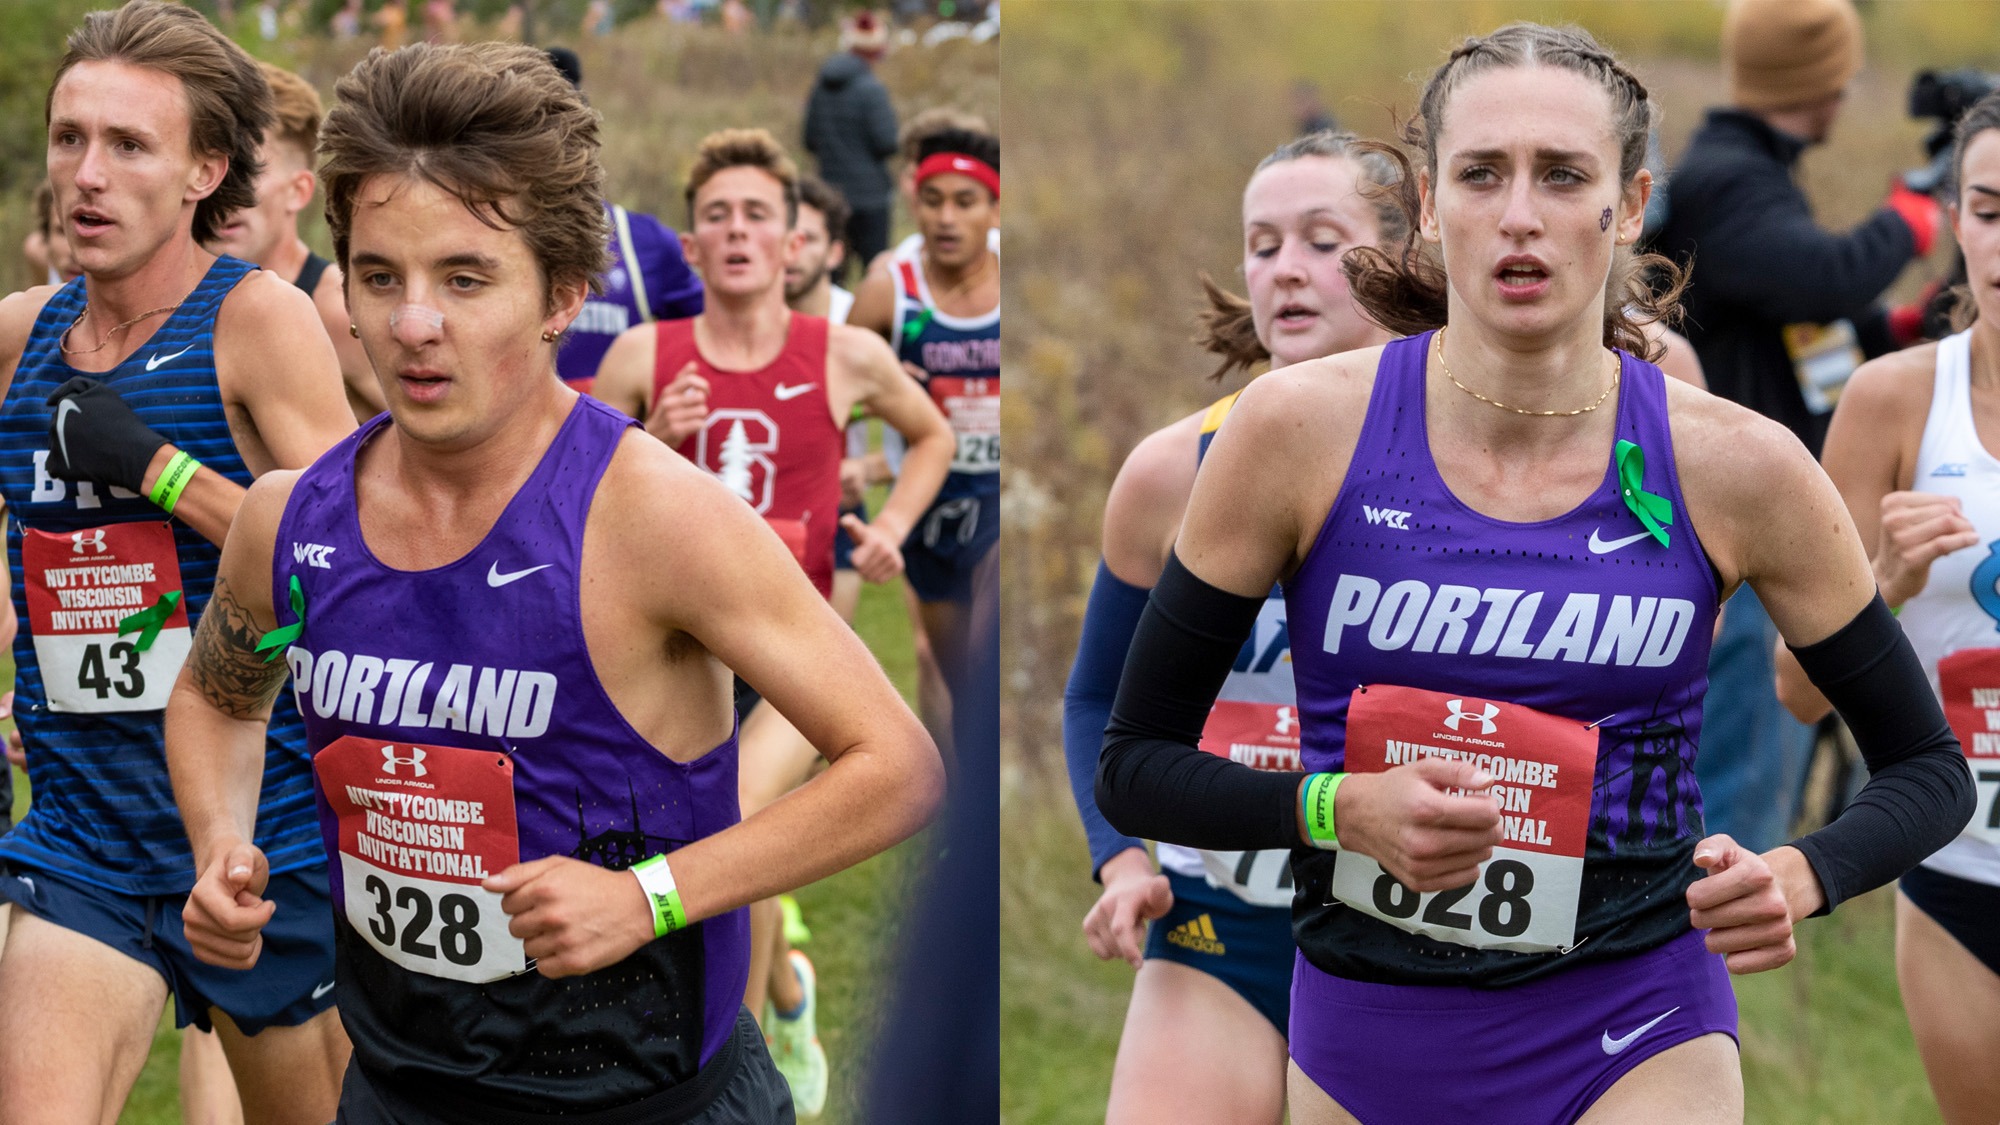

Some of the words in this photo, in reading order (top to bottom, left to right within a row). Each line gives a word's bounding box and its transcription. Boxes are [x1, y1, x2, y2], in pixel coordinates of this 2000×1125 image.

[44, 562, 156, 588] NUTTYCOMBE
[57, 585, 143, 609] WISCONSIN
[1322, 573, 1696, 668] PORTLAND
[77, 641, 146, 699] 43
[285, 645, 558, 738] PORTLAND
[1432, 732, 1464, 742] UNDER
[1465, 737, 1506, 748] ARMOUR
[374, 777, 402, 786] UNDER
[403, 780, 435, 790] ARMOUR
[345, 785, 485, 825] NUTTYCOMBE
[365, 809, 465, 851] WISCONSIN
[356, 831, 489, 879] INVITATIONAL
[365, 873, 483, 967] 328
